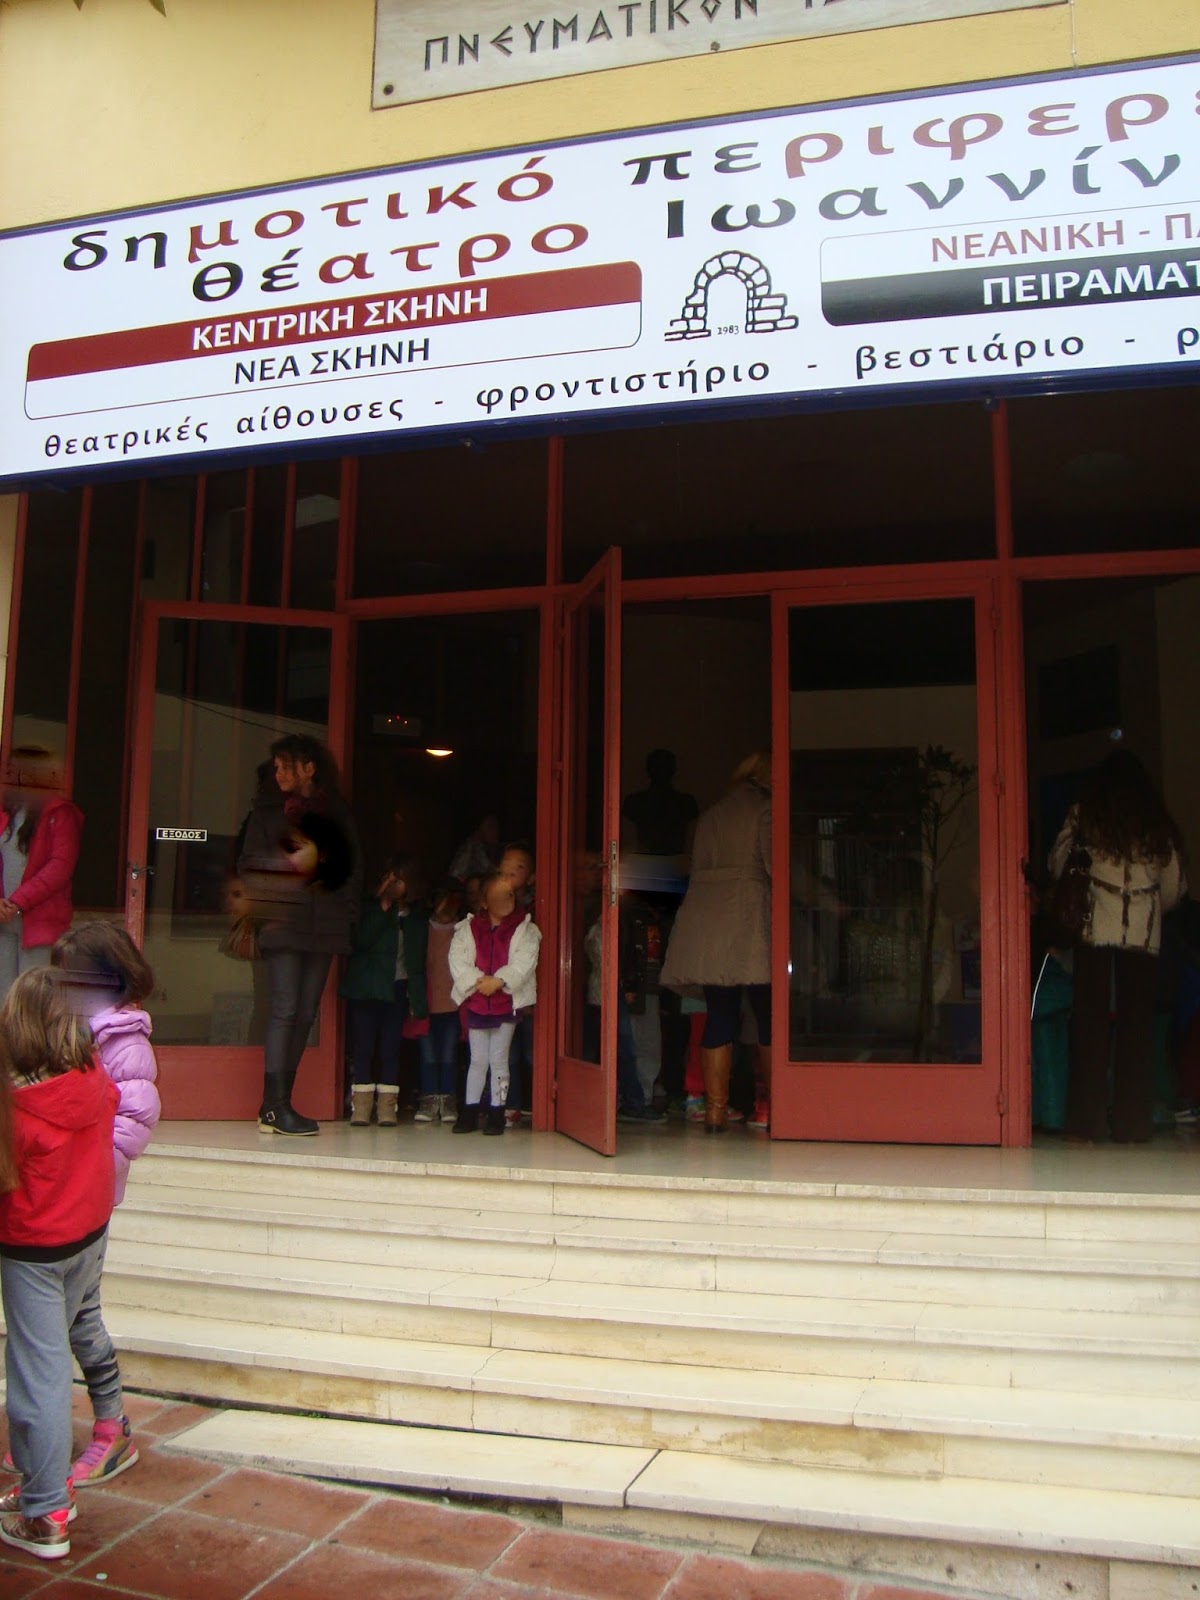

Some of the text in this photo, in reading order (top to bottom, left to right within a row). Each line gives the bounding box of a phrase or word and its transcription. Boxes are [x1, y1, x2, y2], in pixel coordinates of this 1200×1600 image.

[63, 91, 1200, 272] δημοτικό περιφερ
[192, 145, 1181, 303] θέατρο Ιωαννίν
[932, 219, 1124, 262] ΝΕΑΝΙΚΗ
[1165, 212, 1200, 241] Π
[192, 287, 488, 351] ΚΕΝΤΡΙΚΗ ΣΚΗΝΗ
[717, 325, 740, 335] 1983
[234, 337, 430, 385] ΝΕΑ ΣΚΗΝΗ
[44, 415, 209, 458] θεατρικές
[236, 398, 404, 434] αίθουσες
[476, 359, 770, 415] φροντιστήριο
[855, 332, 1084, 380] βεστιάριο
[162, 829, 202, 839] ΕΞΟΔΟΣ
